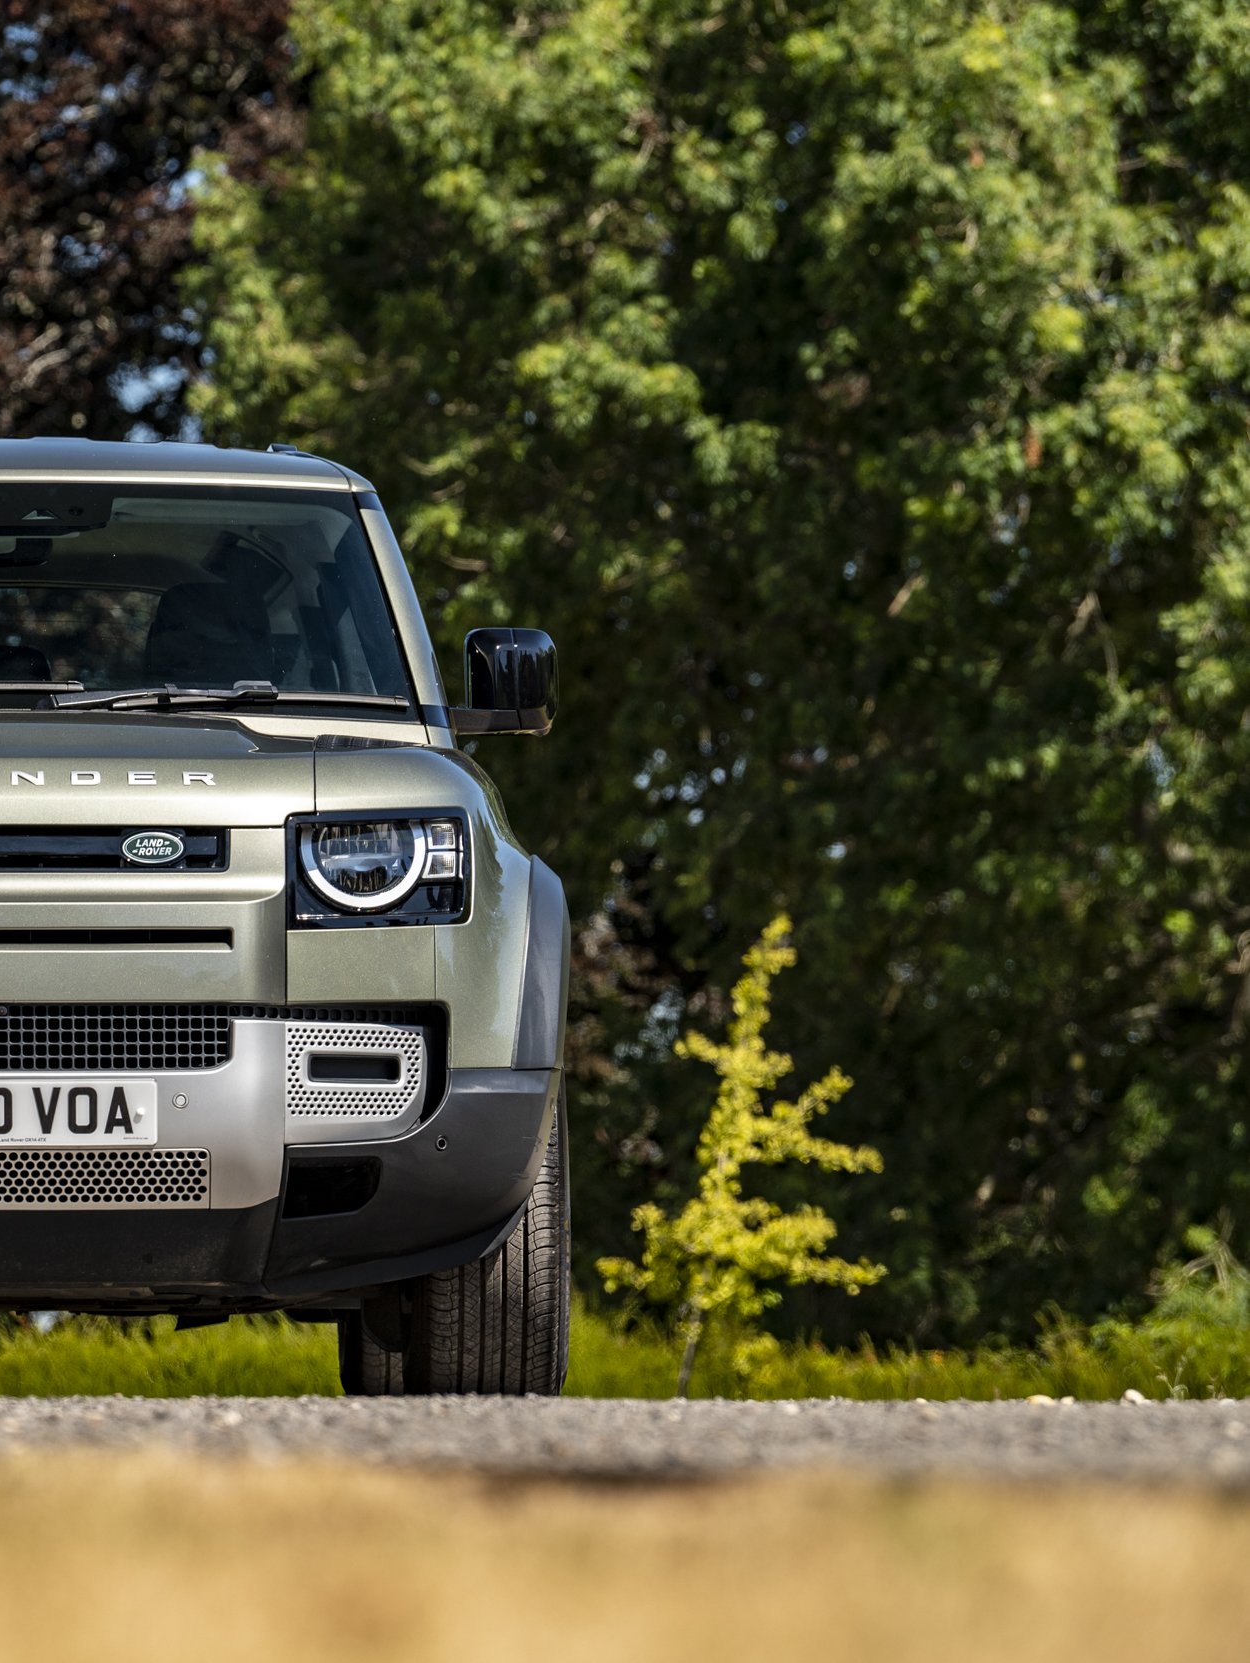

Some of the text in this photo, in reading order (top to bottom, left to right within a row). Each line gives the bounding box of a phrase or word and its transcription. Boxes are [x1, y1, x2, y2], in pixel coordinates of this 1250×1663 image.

[136, 839, 164, 847] LAND
[138, 847, 172, 856] ROVER
[32, 1086, 134, 1135] VOA
